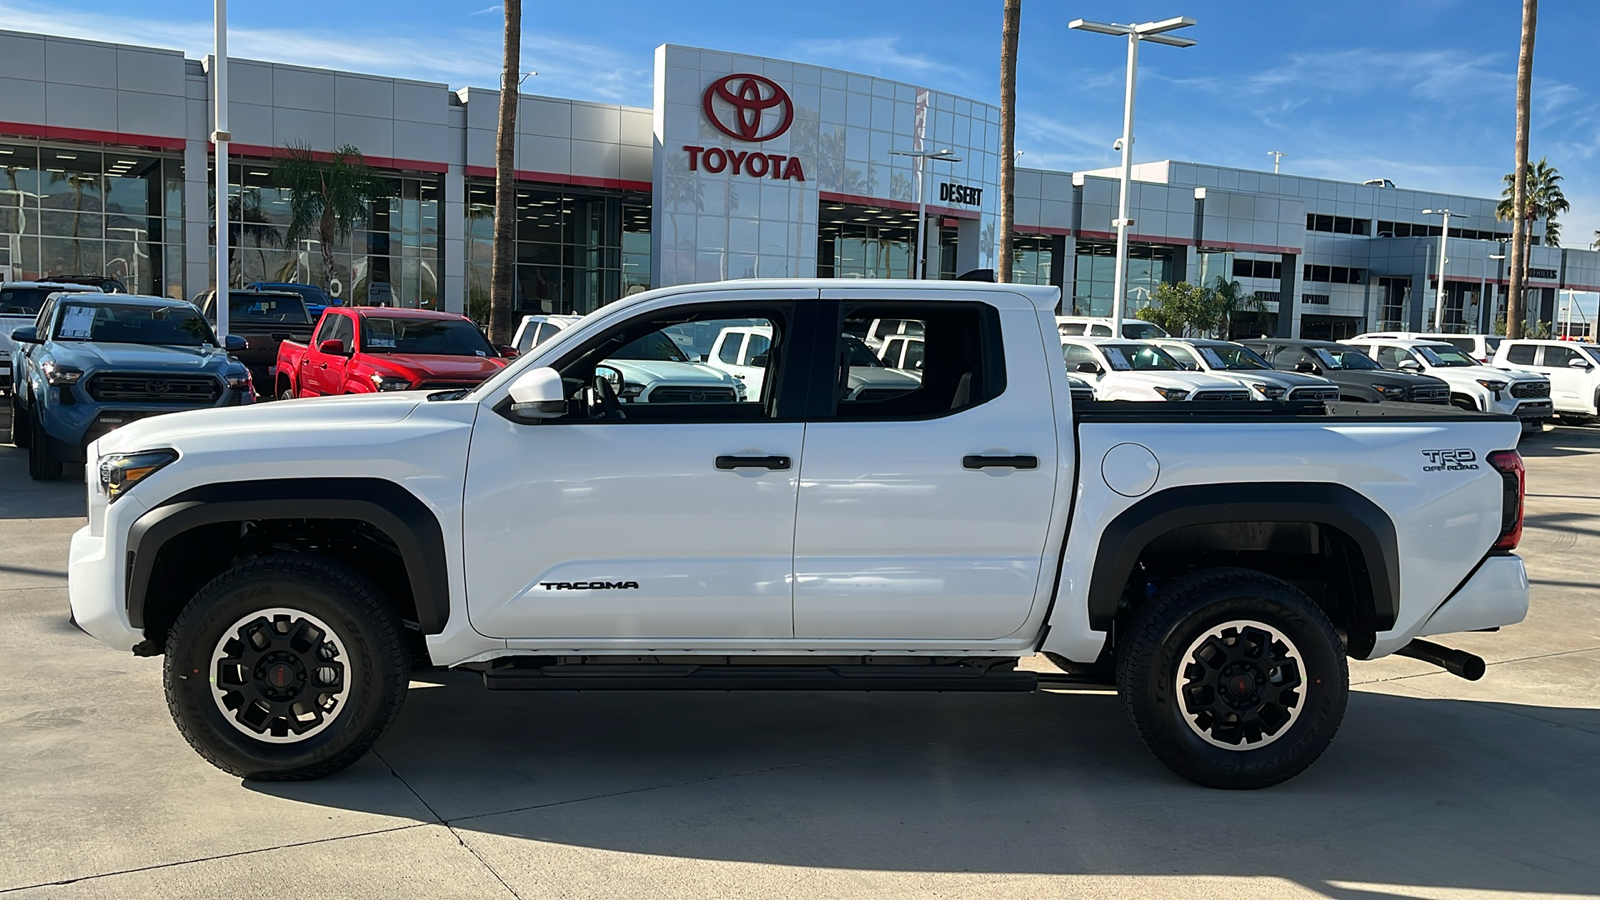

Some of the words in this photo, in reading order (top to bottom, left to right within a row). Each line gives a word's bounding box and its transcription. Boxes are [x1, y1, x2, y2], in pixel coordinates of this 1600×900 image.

[682, 145, 805, 182] TOYOTA
[940, 182, 982, 206] DESERT
[1422, 448, 1476, 466] TRD
[540, 581, 639, 590] TACOMA
